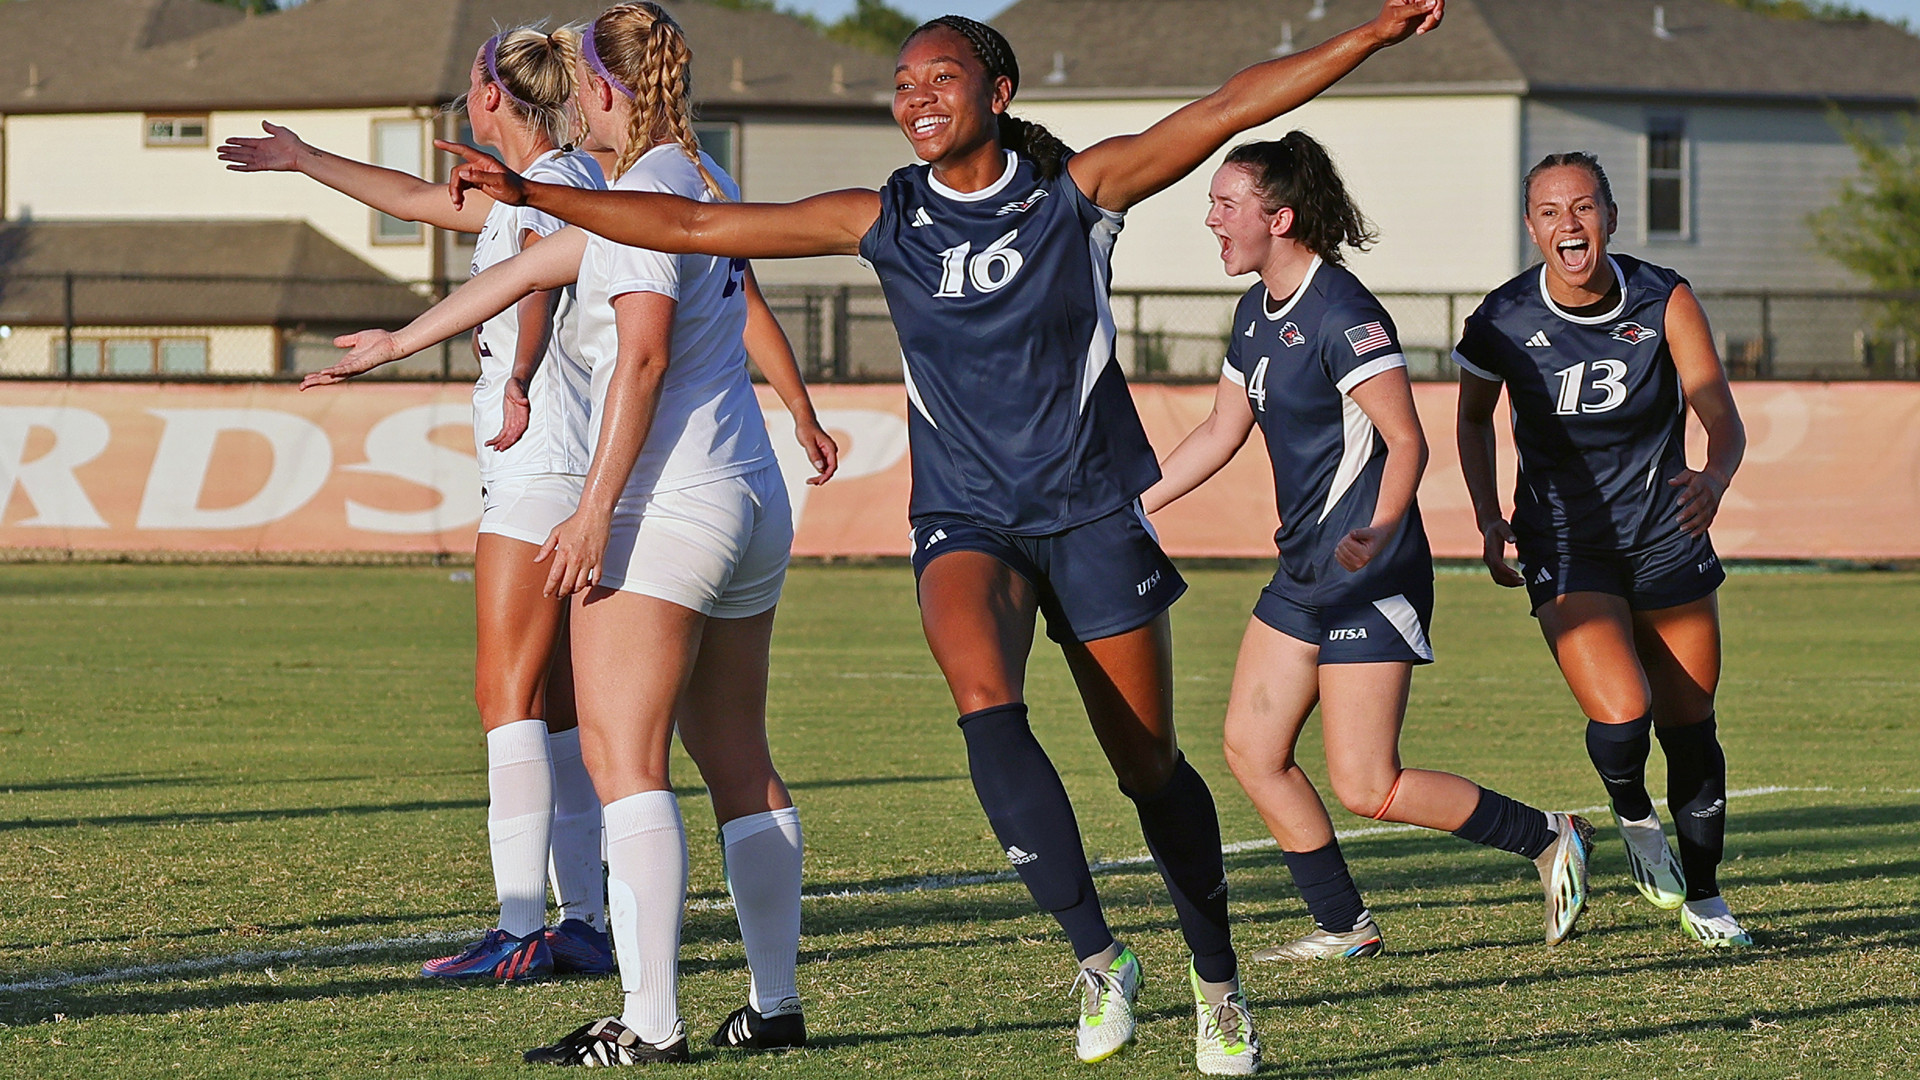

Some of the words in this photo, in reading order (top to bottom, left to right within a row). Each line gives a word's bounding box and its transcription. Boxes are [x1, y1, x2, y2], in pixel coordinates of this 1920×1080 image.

[932, 228, 1025, 298] 16
[1248, 356, 1271, 412] 4
[1551, 358, 1629, 416] 13
[0, 404, 484, 534] RDS
[1136, 569, 1160, 596] UTSA
[1328, 627, 1368, 641] UTSA
[1009, 853, 1039, 865] das
